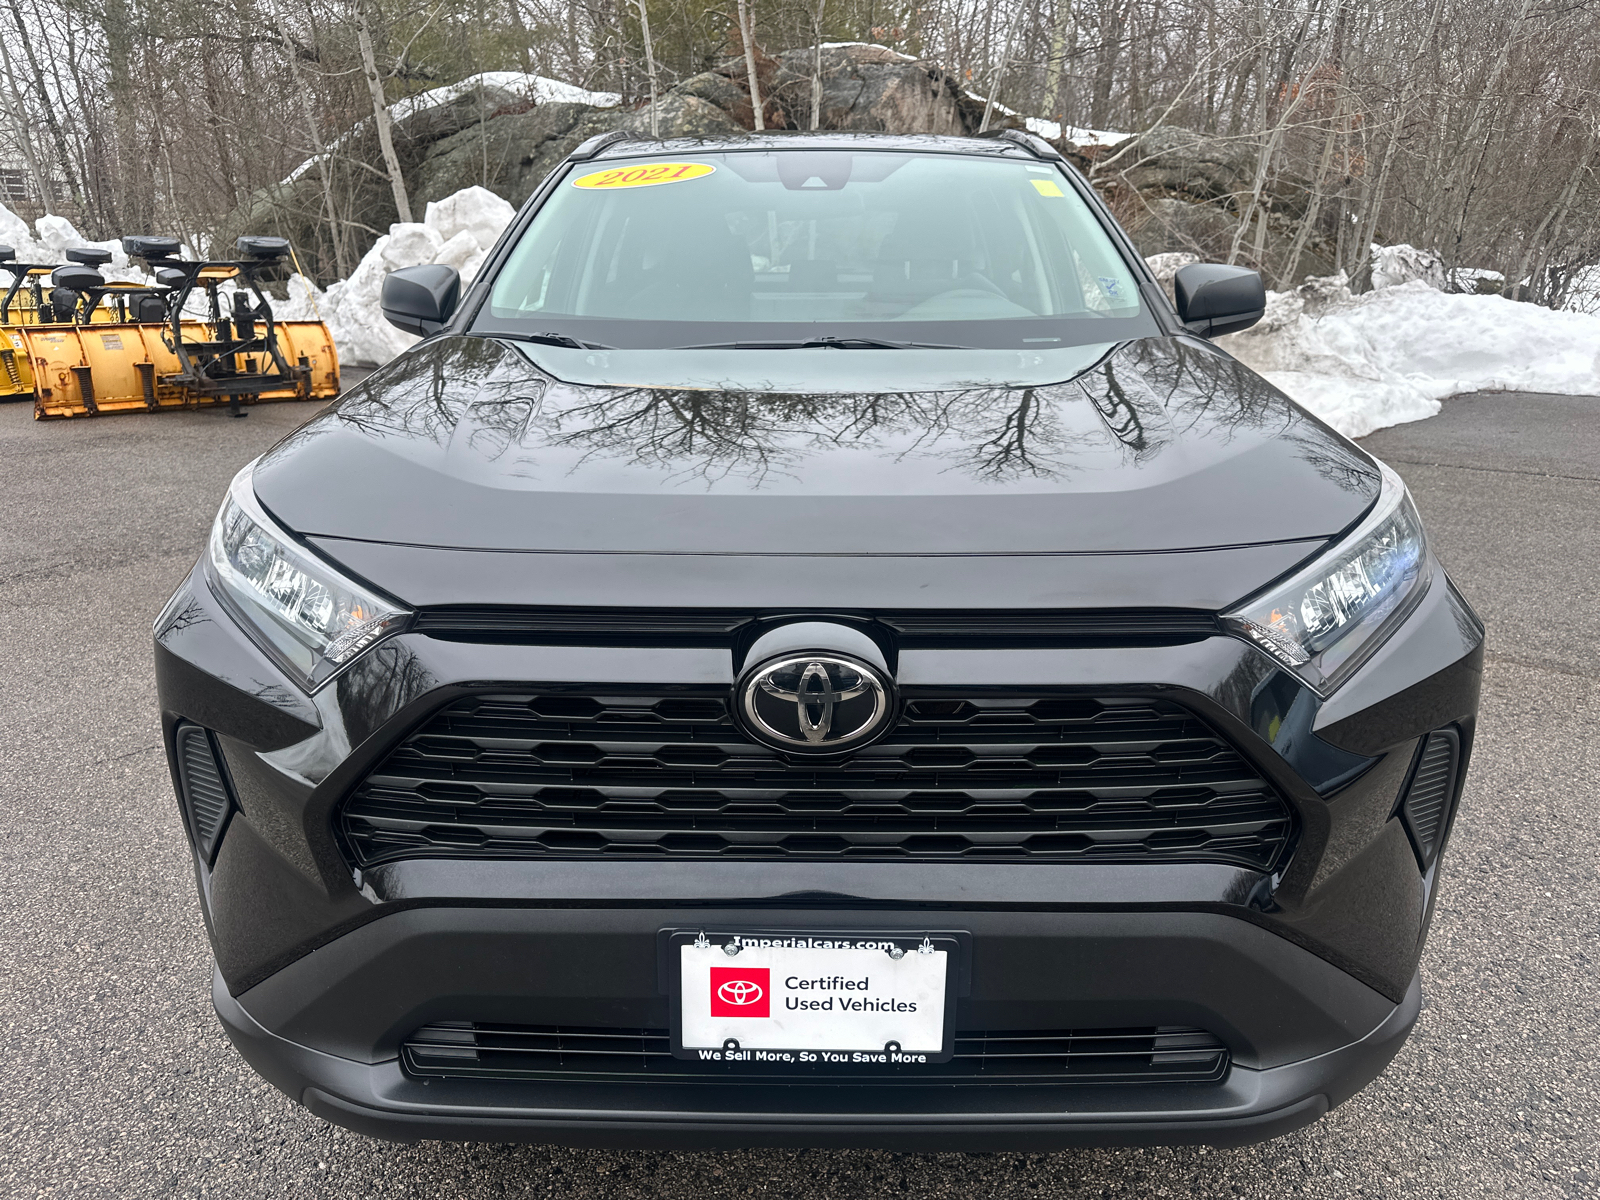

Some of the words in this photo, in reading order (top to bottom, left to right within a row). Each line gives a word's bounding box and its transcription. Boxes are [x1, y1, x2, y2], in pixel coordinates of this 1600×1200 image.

[594, 165, 693, 186] 2021
[733, 936, 895, 950] Imperialcars.com
[785, 976, 869, 991] Certified
[785, 997, 833, 1011] Used
[839, 997, 917, 1012] Vehicles
[699, 1050, 721, 1061] We
[725, 1050, 750, 1061] Sell
[756, 1051, 795, 1063] More,
[799, 1051, 817, 1062] So
[822, 1052, 848, 1062] You
[852, 1052, 886, 1063] Save
[891, 1053, 926, 1063] More
